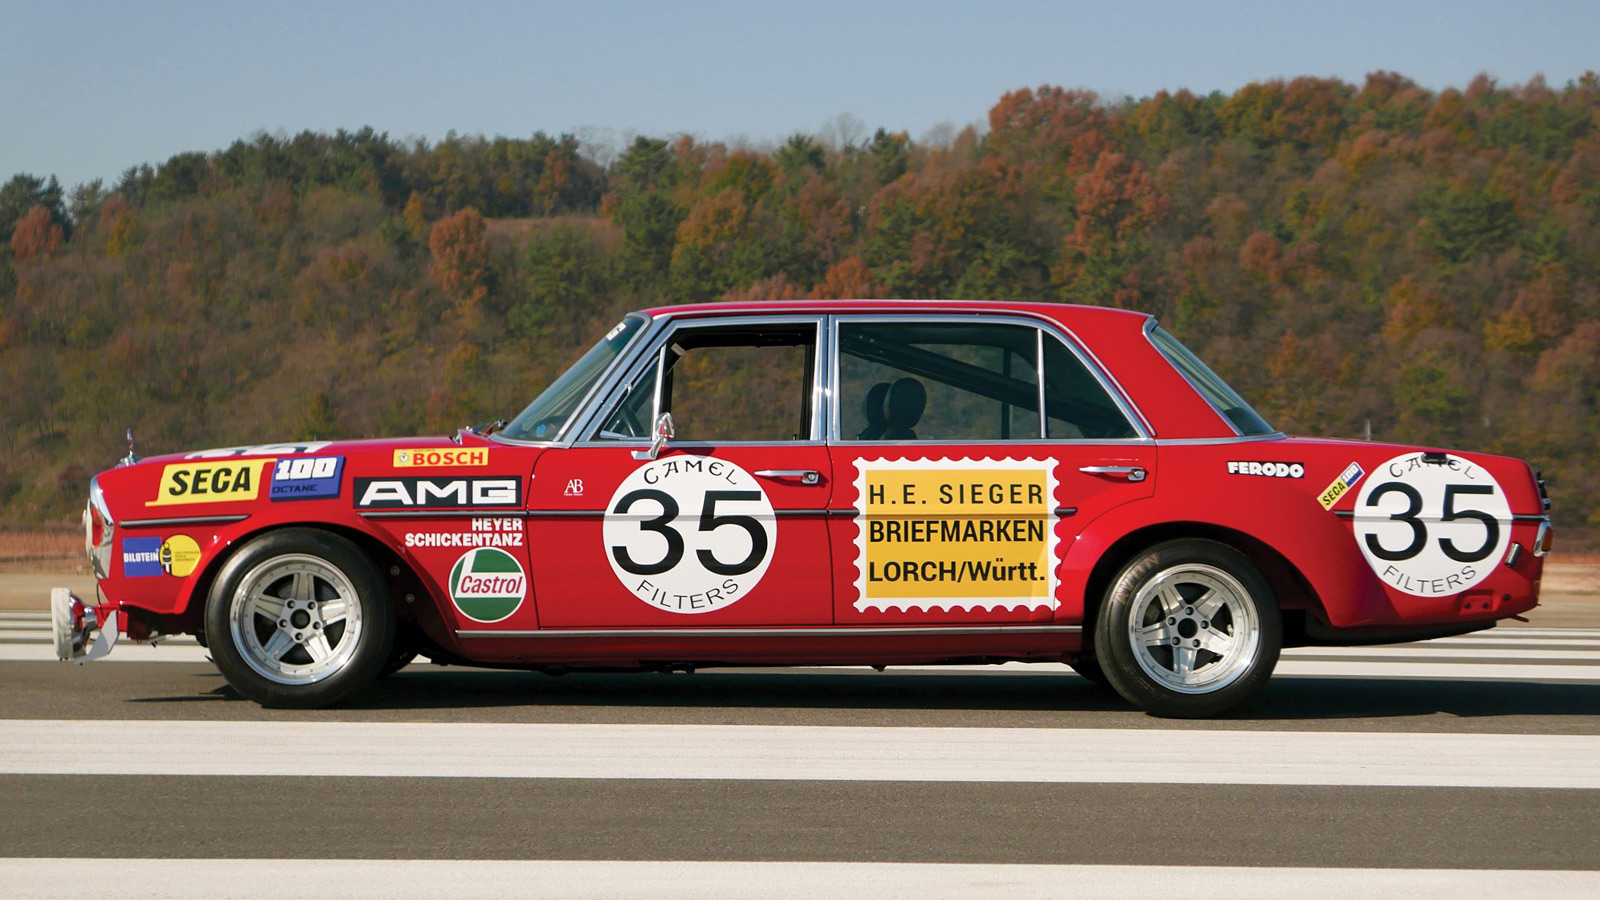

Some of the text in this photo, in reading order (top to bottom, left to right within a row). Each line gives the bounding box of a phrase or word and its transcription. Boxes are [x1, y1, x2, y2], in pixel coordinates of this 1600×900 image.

[412, 452, 484, 466] BOSCH
[1227, 461, 1305, 478] FERODO
[1389, 457, 1475, 479] CAEL
[168, 457, 338, 496] SECA 100
[643, 460, 737, 485] CAMEL
[271, 483, 318, 494] OCTANE
[359, 480, 516, 506] AMG
[939, 484, 1043, 504] SIEGER
[1322, 482, 1346, 506] SECA
[471, 518, 523, 531] HEYER
[612, 488, 768, 576] 35
[869, 520, 1044, 543] BRIEFMARKEN
[1364, 481, 1500, 562] 35
[404, 533, 523, 547] SCHICKENTANZ
[123, 552, 159, 563] BILSTEIN
[869, 557, 1046, 583] LORCH/Württ.
[1383, 565, 1477, 593] FILTERS
[460, 576, 523, 594] Castrol
[636, 578, 739, 609] FILTERS
